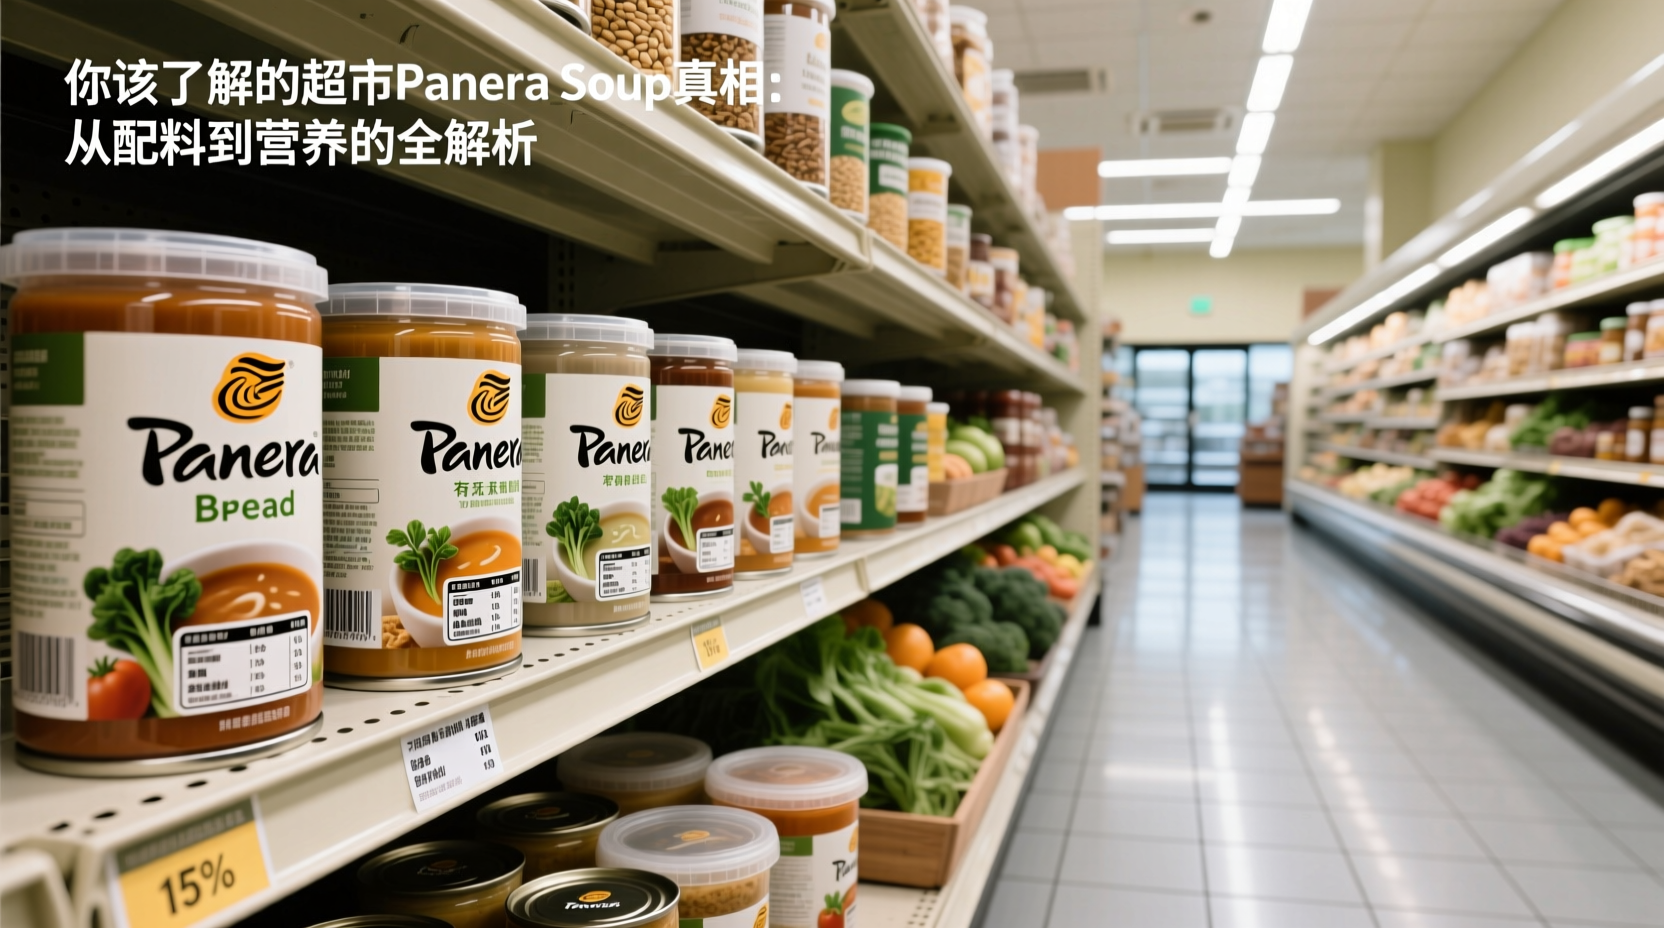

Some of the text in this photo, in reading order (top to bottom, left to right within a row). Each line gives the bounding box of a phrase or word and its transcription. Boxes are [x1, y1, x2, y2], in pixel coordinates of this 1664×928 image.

[127, 416, 319, 486] Panera
[569, 424, 650, 468] Paner
[159, 852, 236, 915] 15%
